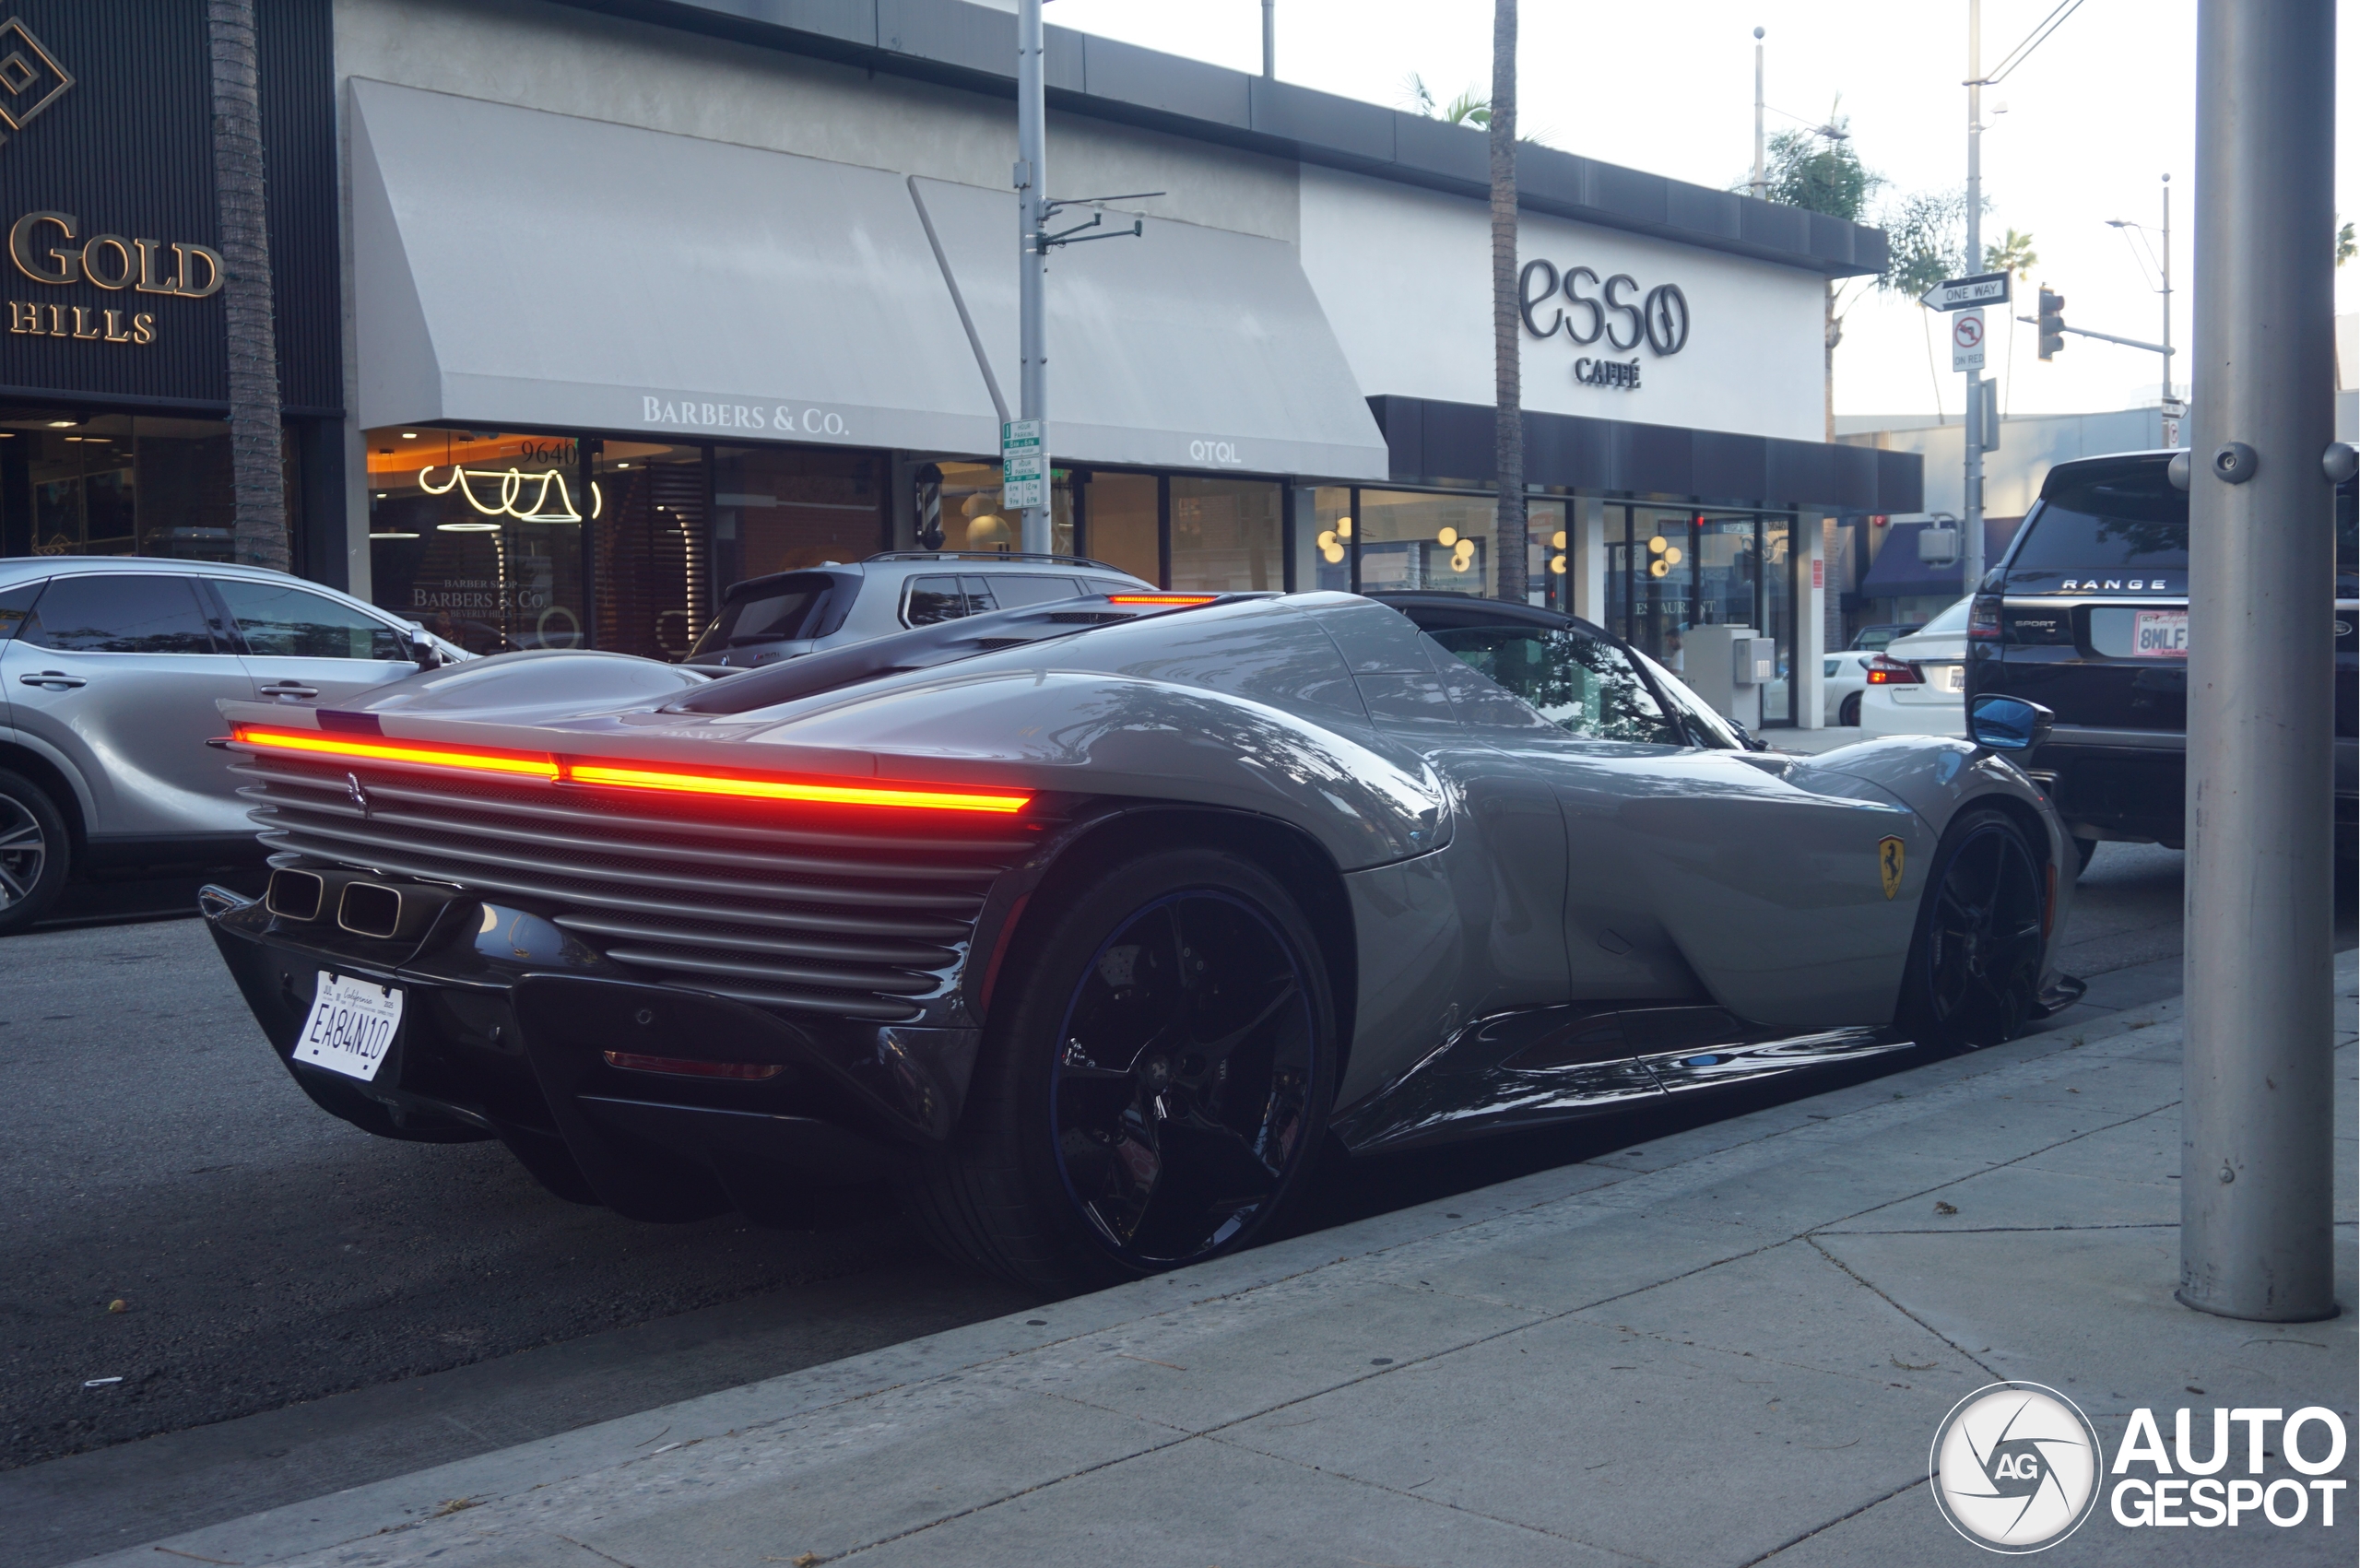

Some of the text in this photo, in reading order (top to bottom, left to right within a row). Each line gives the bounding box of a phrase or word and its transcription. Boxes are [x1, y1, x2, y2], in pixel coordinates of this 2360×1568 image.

[9, 210, 225, 298] GOLD
[1946, 282, 1998, 301] ONE WAY
[1519, 258, 1690, 358] esso
[9, 301, 158, 345] HILLS
[1955, 353, 1984, 366] ON RED
[1575, 357, 1642, 389] CAFFÉ
[643, 395, 850, 436] BARBERS & CO.
[521, 441, 578, 466] 9640
[1190, 440, 1242, 463] QTQL
[1005, 461, 1011, 475] 3
[444, 580, 487, 589] BARBER
[2062, 579, 2166, 590] RANGE
[413, 588, 493, 608] BARBERS
[450, 608, 513, 619] BEVERLY HILLS
[2140, 628, 2189, 650] 8MLF
[343, 986, 373, 1008] California
[310, 1003, 389, 1060] EA84N10
